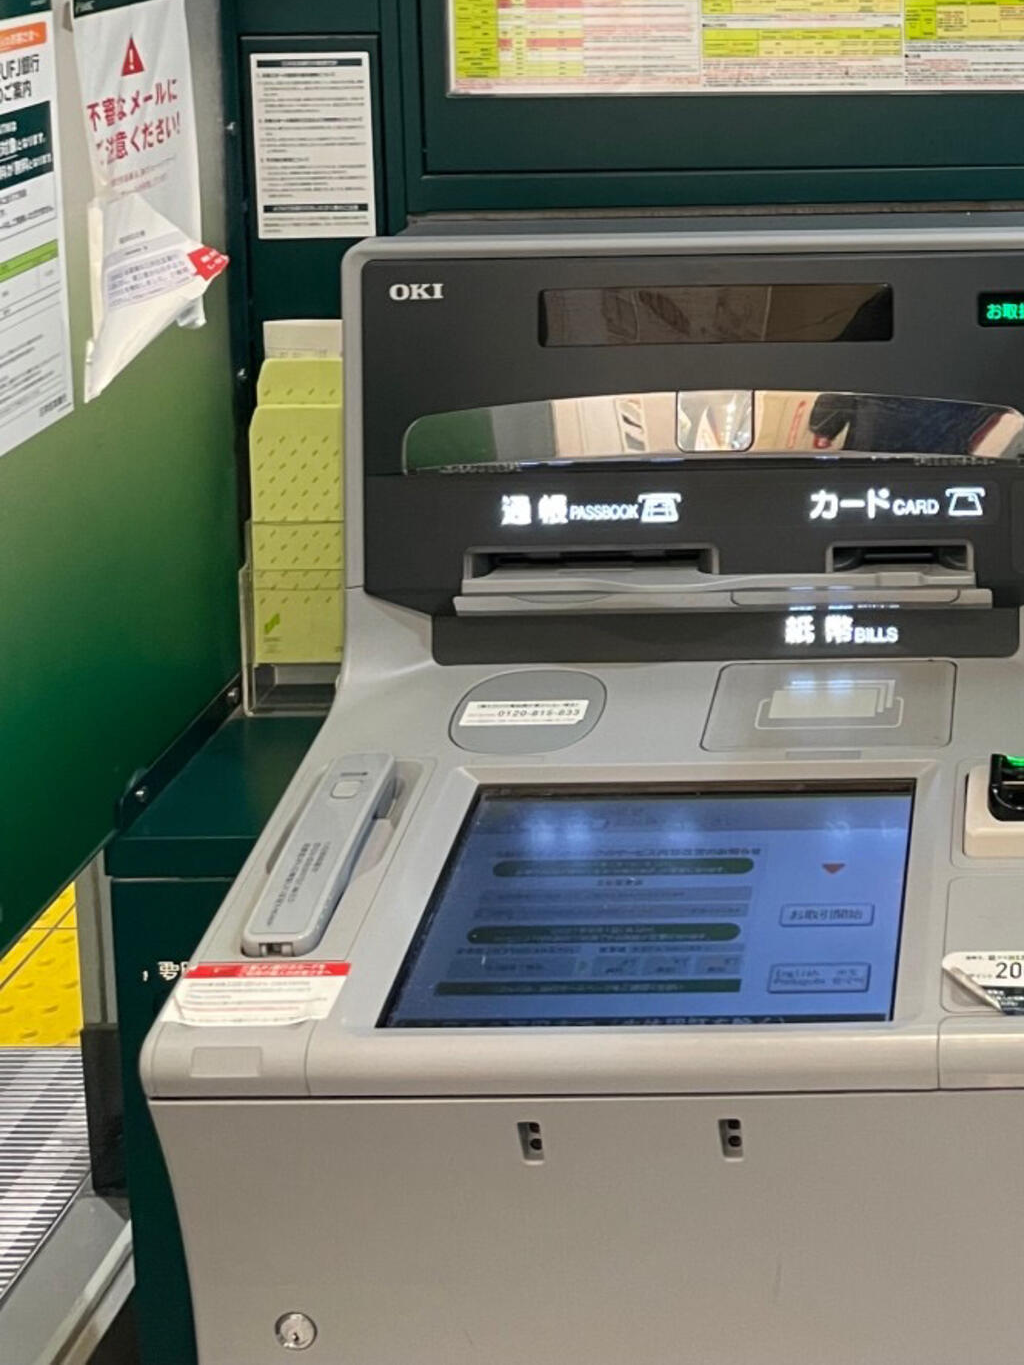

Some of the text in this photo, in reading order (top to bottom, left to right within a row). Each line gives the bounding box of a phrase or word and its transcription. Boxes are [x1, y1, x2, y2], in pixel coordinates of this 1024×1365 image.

[389, 283, 444, 301] OKI
[569, 504, 639, 521] PASSBOOK
[809, 488, 940, 519] カード CARD
[854, 625, 899, 644] BILLS
